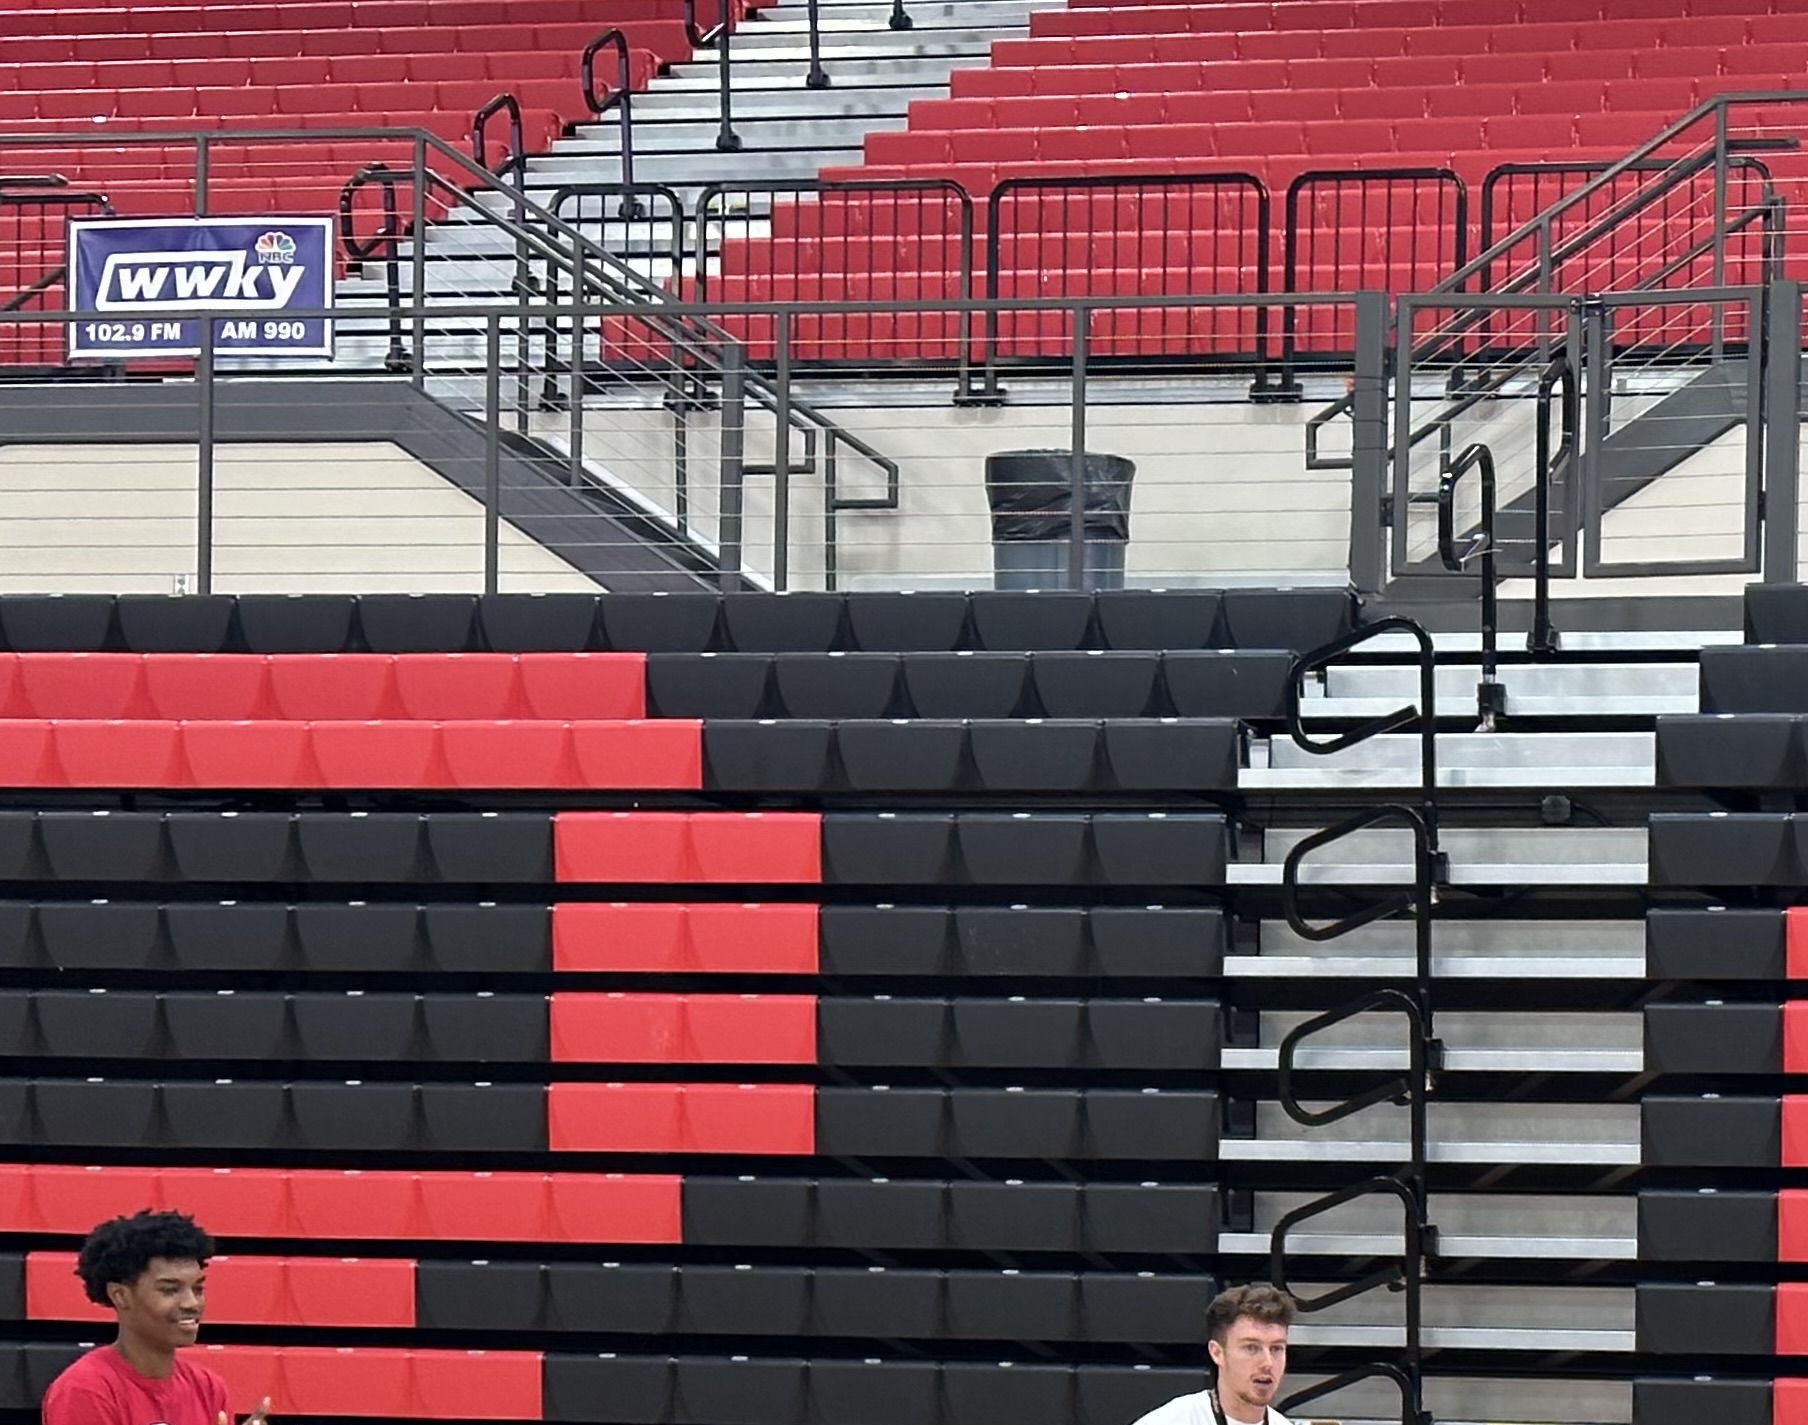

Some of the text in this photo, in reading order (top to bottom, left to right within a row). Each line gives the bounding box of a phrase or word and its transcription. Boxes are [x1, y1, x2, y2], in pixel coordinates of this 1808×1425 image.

[258, 251, 294, 264] NBC
[86, 321, 305, 341] 102.9 FM AM 990
